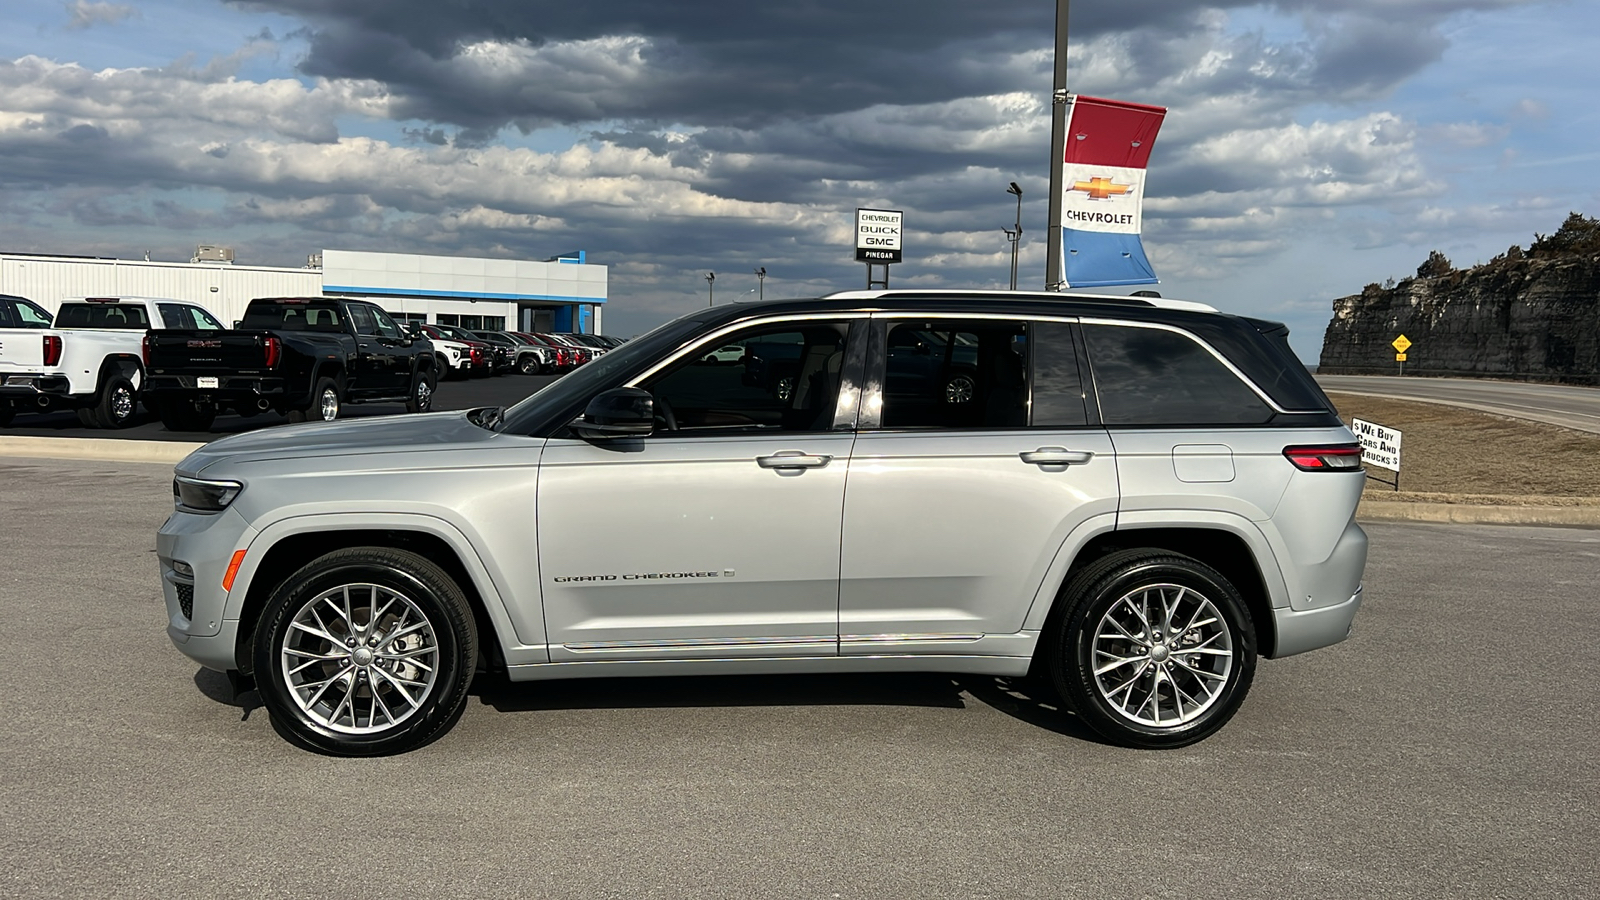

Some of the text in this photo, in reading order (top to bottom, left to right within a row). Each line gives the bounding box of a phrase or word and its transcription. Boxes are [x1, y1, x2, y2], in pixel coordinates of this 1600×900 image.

[861, 214, 899, 223] CHEVROLET
[1066, 209, 1133, 225] CHEVROLET
[860, 225, 899, 235] BUICK
[865, 237, 894, 246] GMC
[865, 251, 894, 259] PINEGAR
[1377, 427, 1394, 442] BUY
[1380, 440, 1397, 455] AND
[553, 570, 719, 583] GRAND CHEROKEE
